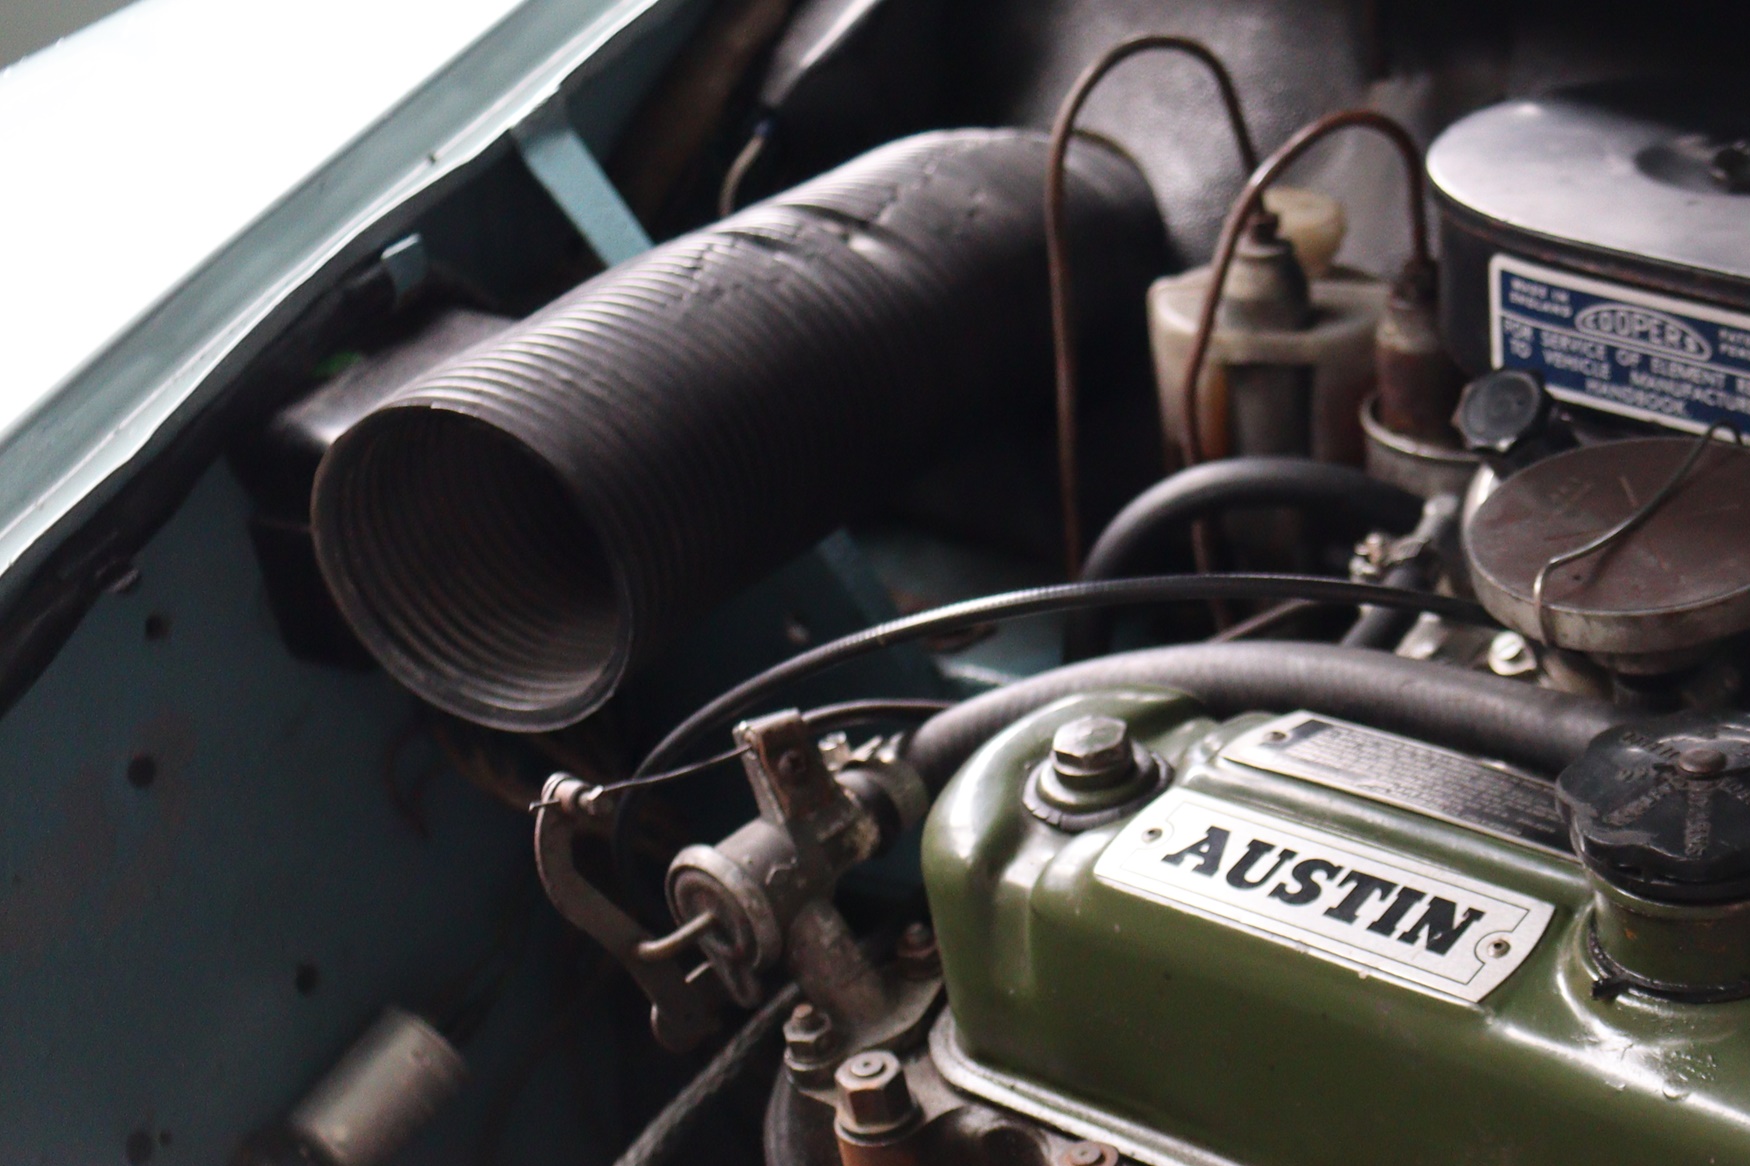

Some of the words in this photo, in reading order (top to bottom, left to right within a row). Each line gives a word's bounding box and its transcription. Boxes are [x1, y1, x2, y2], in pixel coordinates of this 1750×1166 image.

[1503, 318, 1534, 343] FOR
[1540, 328, 1607, 360] SERVICE
[1614, 348, 1641, 367] OF
[1650, 356, 1727, 389] ELEMENT
[1510, 337, 1533, 359] TO
[1543, 349, 1612, 381] VEHICLE
[1584, 310, 1700, 354] COOPERS
[1160, 825, 1486, 956] AUSTIN
